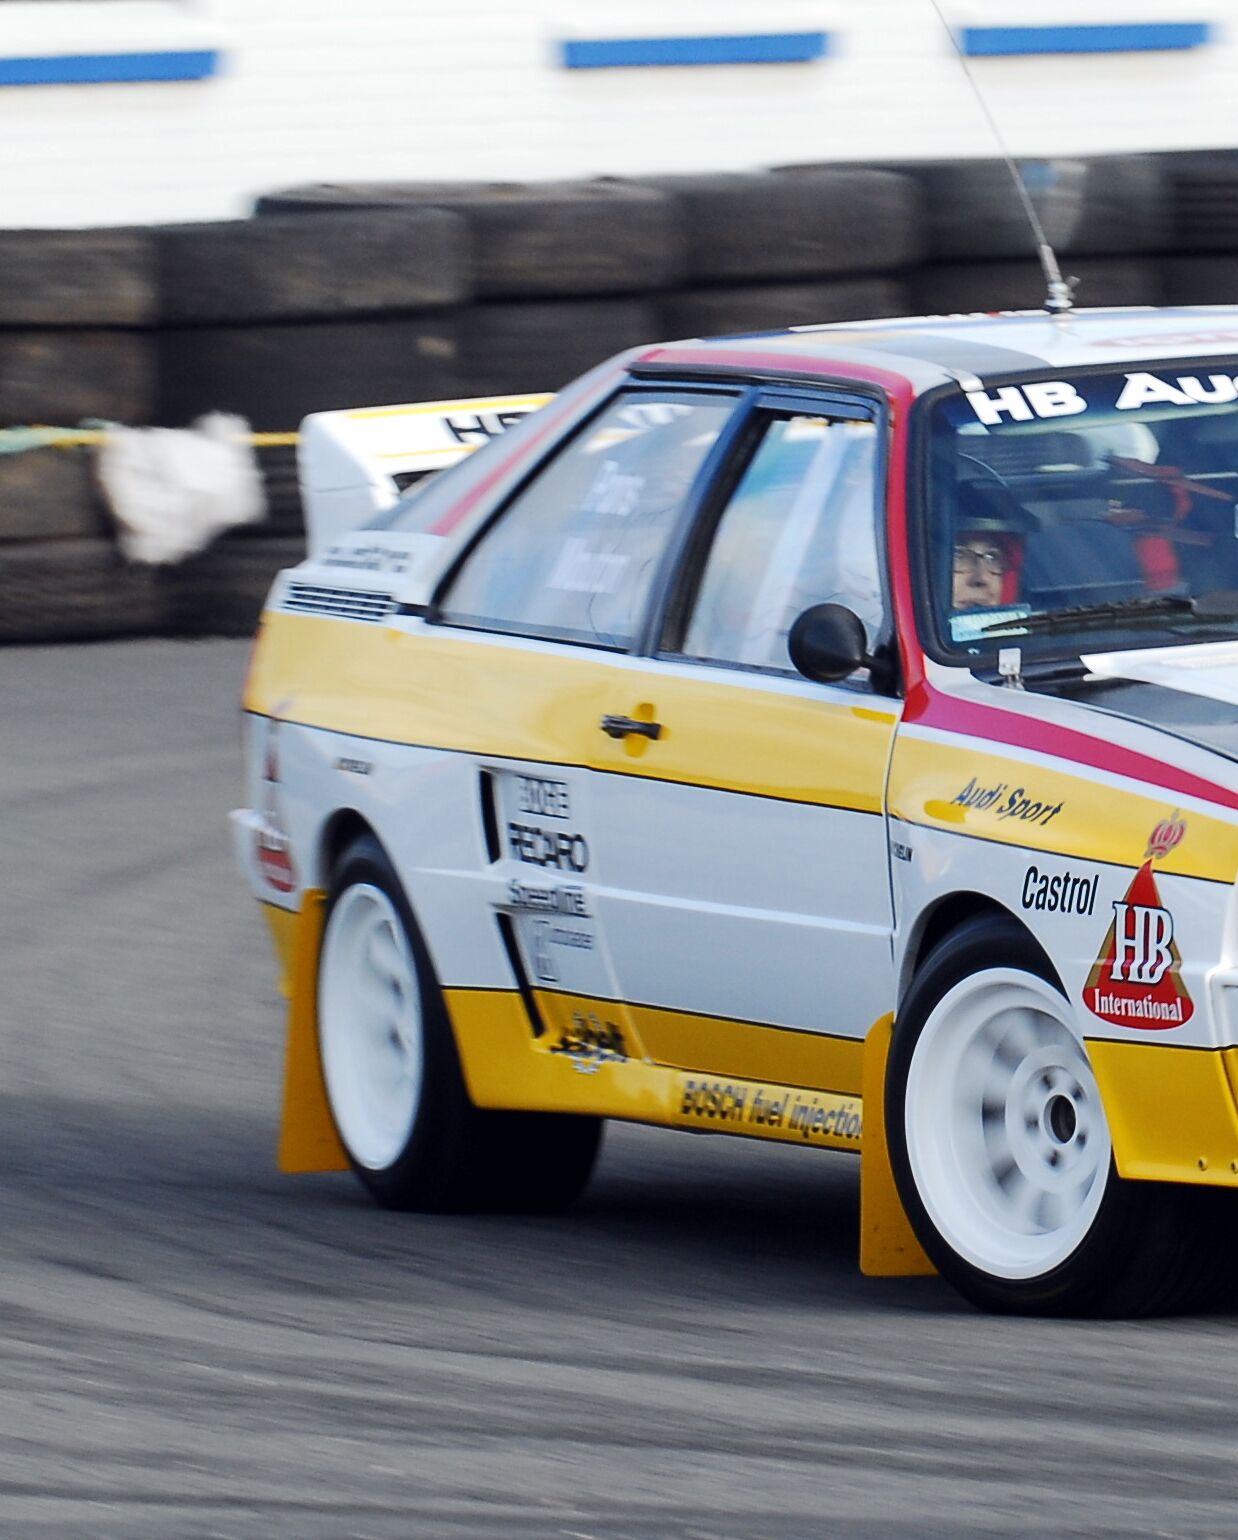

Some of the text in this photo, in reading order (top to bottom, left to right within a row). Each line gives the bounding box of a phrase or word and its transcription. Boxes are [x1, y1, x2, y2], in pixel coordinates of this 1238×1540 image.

[968, 379, 1088, 425] HB
[949, 776, 1066, 827] Audi Sport
[1021, 864, 1100, 916] Castrol
[1109, 900, 1175, 985] HB
[1094, 988, 1183, 1022] International
